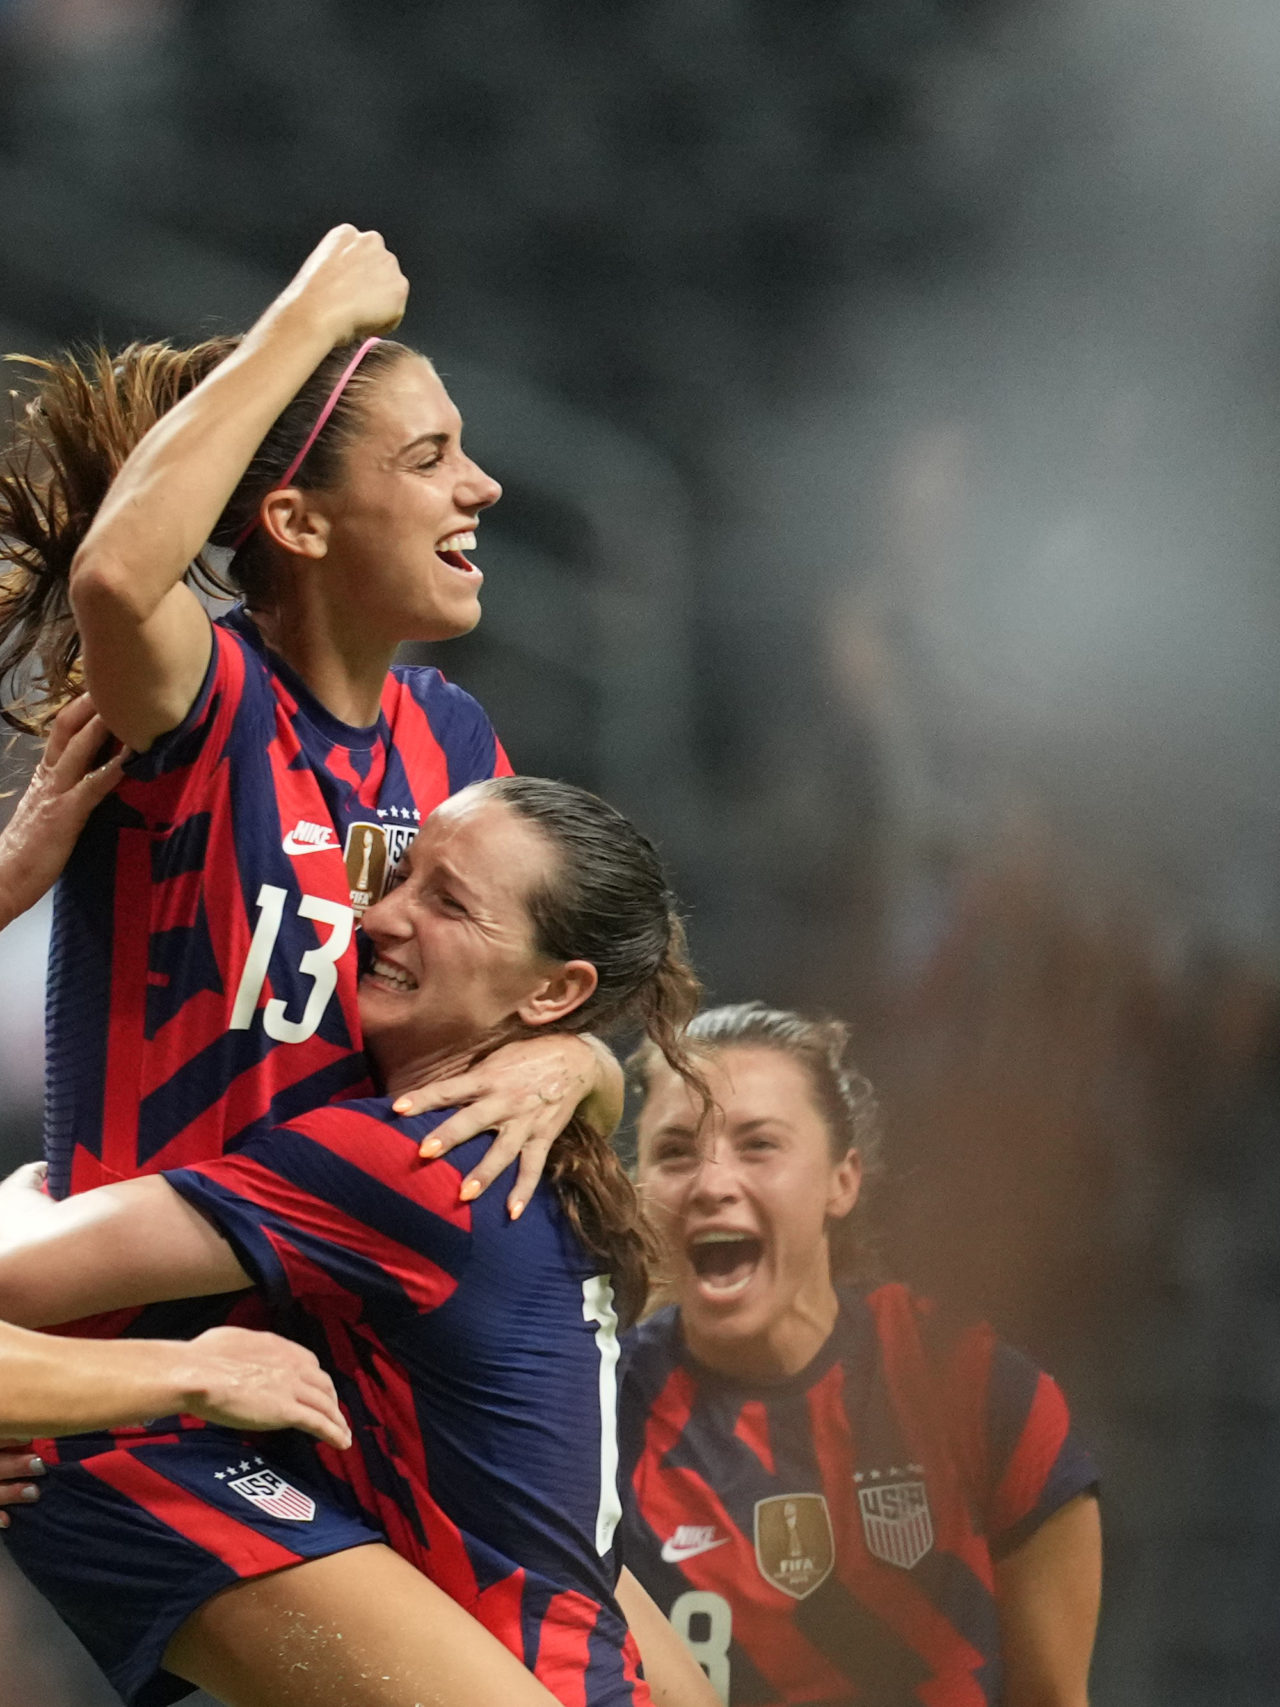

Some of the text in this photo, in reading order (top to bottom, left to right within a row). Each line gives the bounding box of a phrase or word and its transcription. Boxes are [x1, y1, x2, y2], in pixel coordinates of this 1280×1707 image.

[292, 820, 333, 845] NIKE
[228, 884, 354, 1044] 13
[233, 1471, 284, 1498] USA
[862, 1485, 924, 1522] USA
[672, 1525, 717, 1547] NIKE
[780, 1558, 814, 1573] FIFA
[670, 1590, 733, 1707] 8
